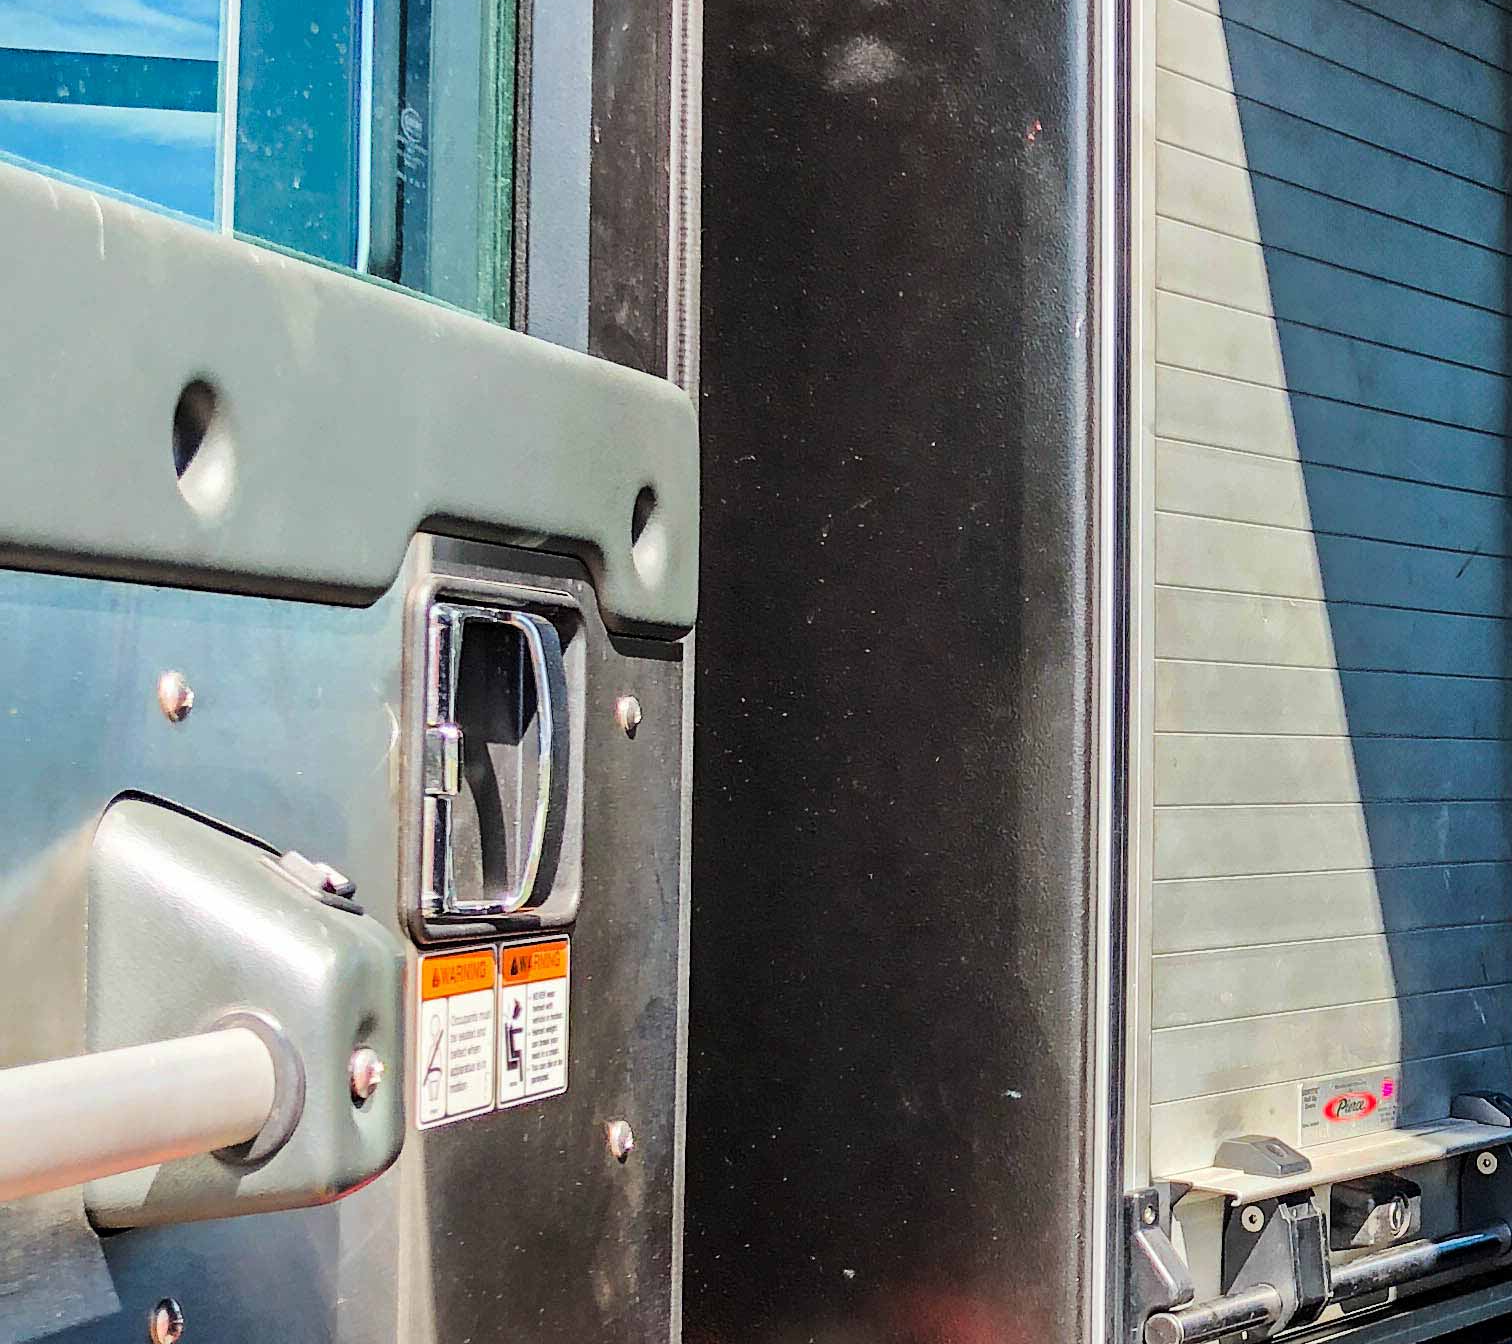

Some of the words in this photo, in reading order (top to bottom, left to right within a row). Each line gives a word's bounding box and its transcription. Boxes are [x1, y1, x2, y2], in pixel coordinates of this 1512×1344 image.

[441, 959, 486, 985] WARNING
[519, 950, 561, 973] WARNING
[1336, 1097, 1366, 1118] Pierce
